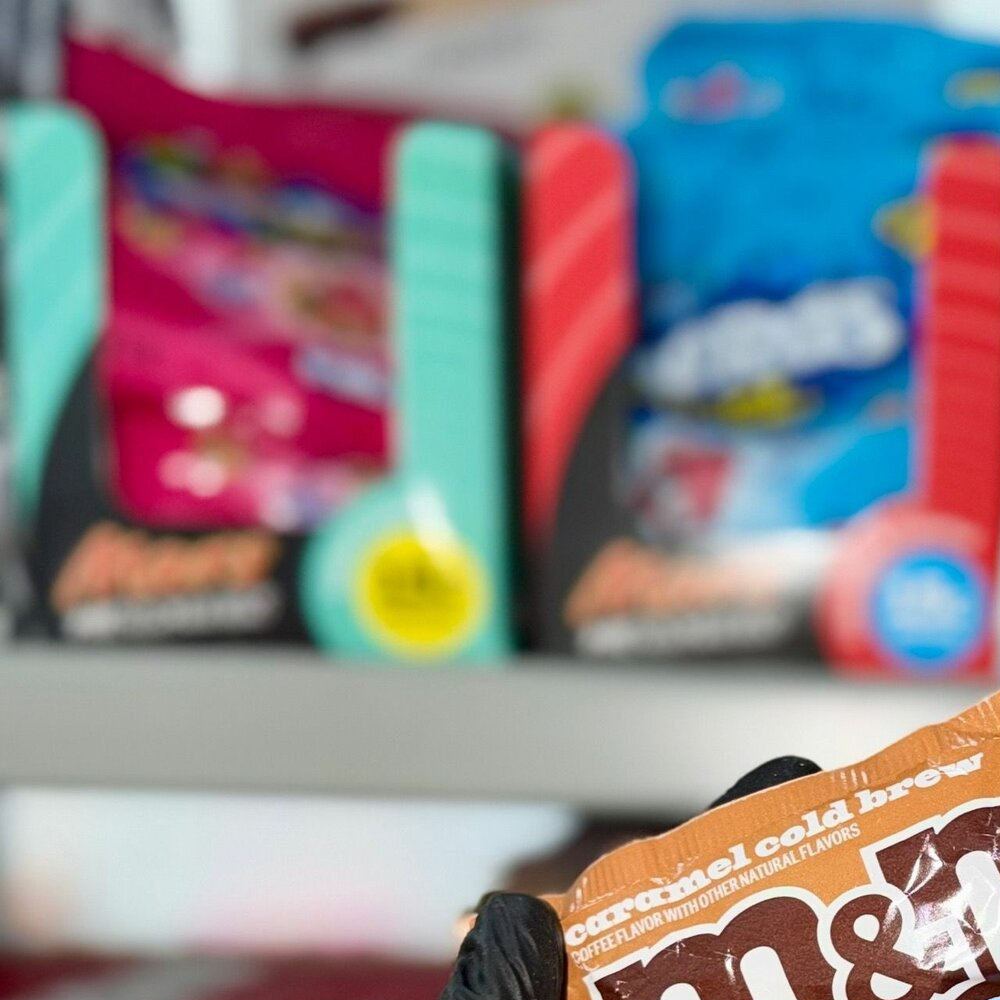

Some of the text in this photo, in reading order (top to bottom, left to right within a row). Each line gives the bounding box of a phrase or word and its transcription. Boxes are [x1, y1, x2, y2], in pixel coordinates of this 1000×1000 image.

[564, 752, 985, 947] caramel cold brew
[570, 822, 861, 964] COFFEE FLAVOR WITH OTHER NATURAL FLAVORS
